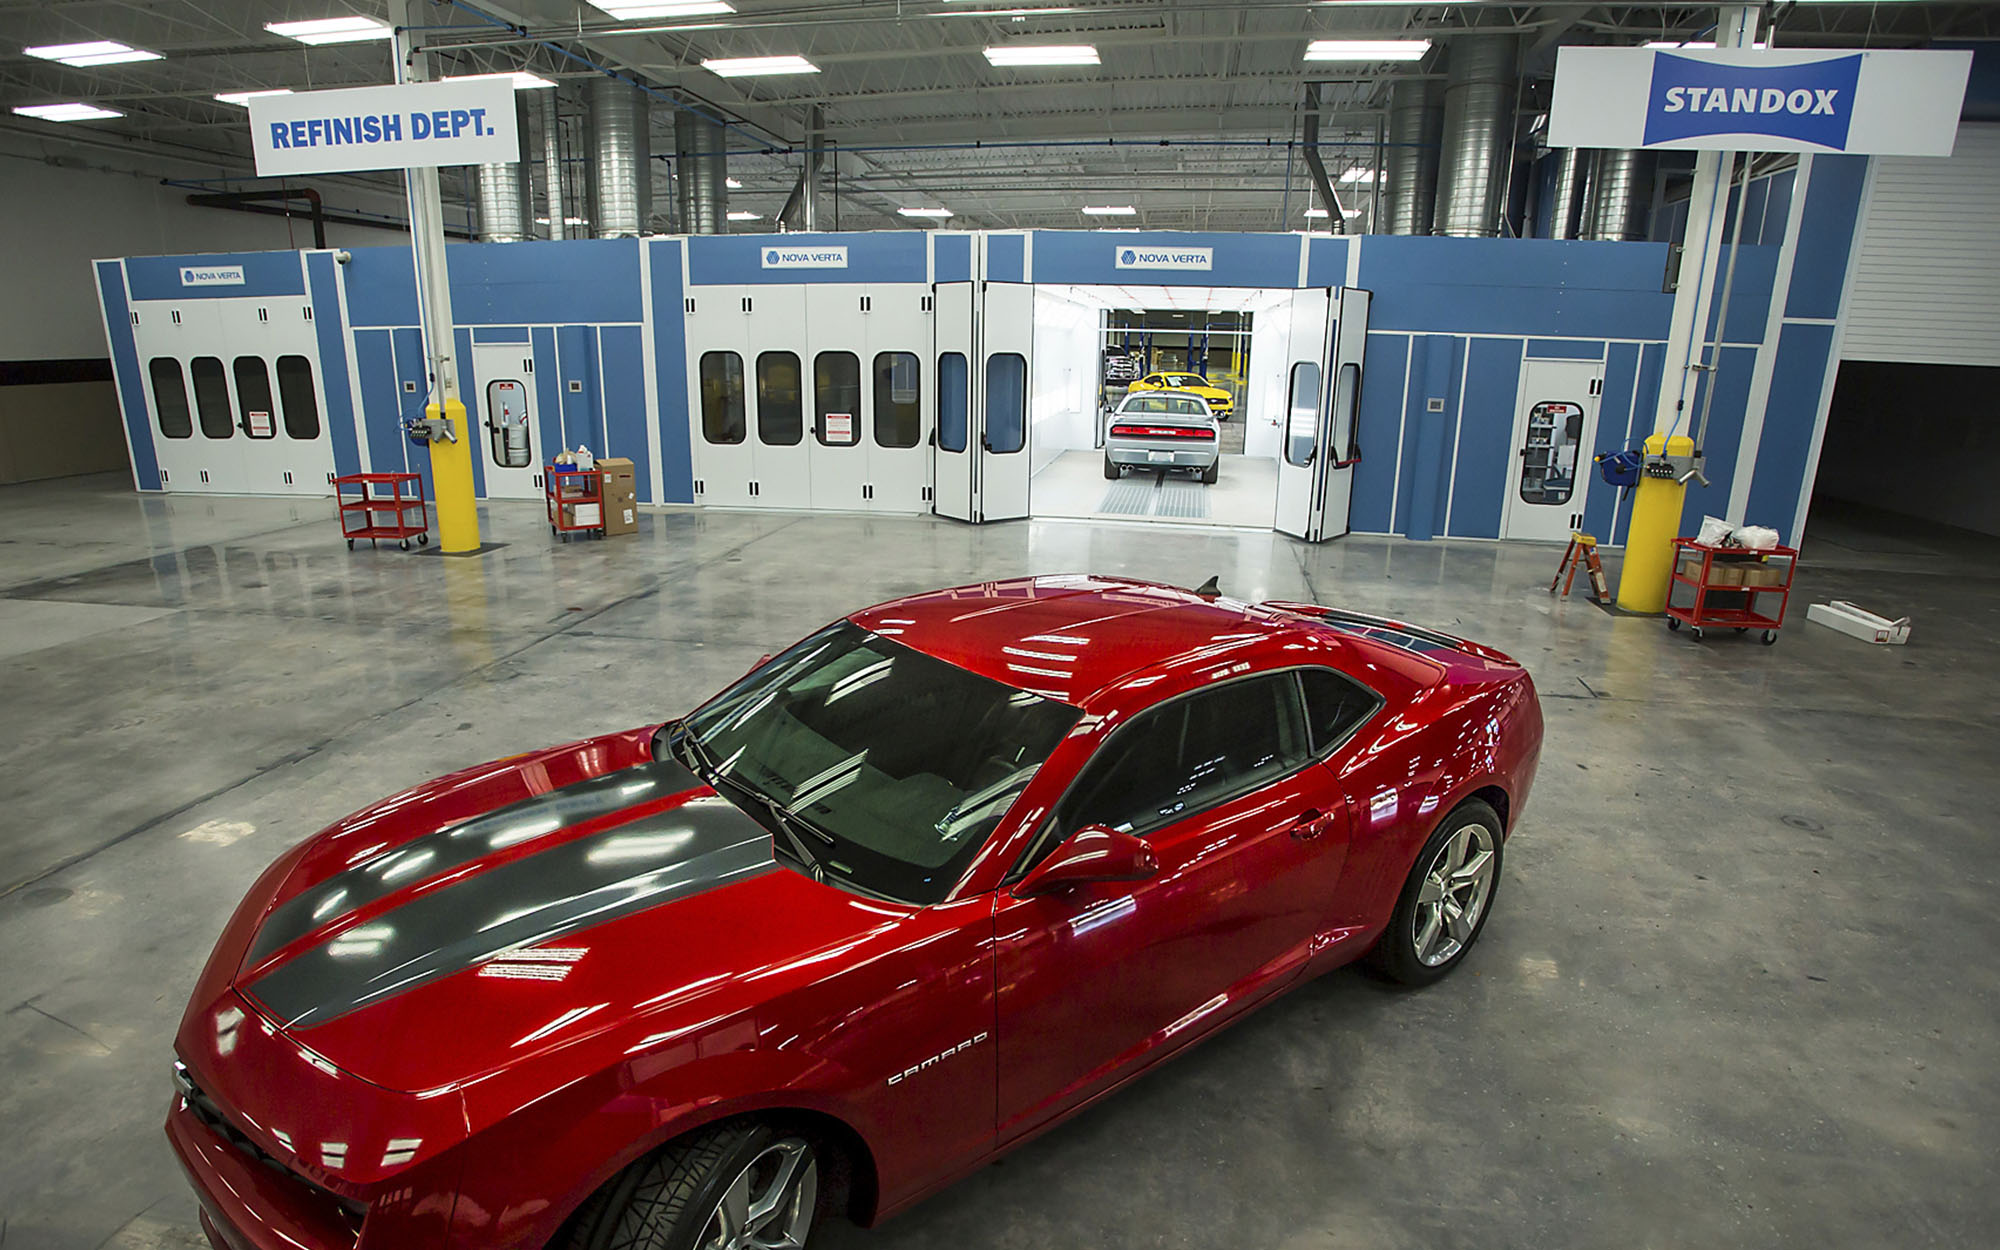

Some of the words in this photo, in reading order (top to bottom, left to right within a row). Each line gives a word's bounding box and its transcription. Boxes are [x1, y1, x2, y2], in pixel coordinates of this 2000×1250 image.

[1663, 86, 1839, 115] STANDOX
[270, 114, 402, 149] REFINISH
[410, 108, 496, 141] DEPT.
[782, 253, 810, 262] NOVA
[811, 253, 843, 262] VERTA
[1139, 253, 1170, 263] NOVA
[1171, 254, 1207, 264] VERTA
[196, 272, 217, 281] NOVA
[887, 1031, 989, 1086] CAMARO
